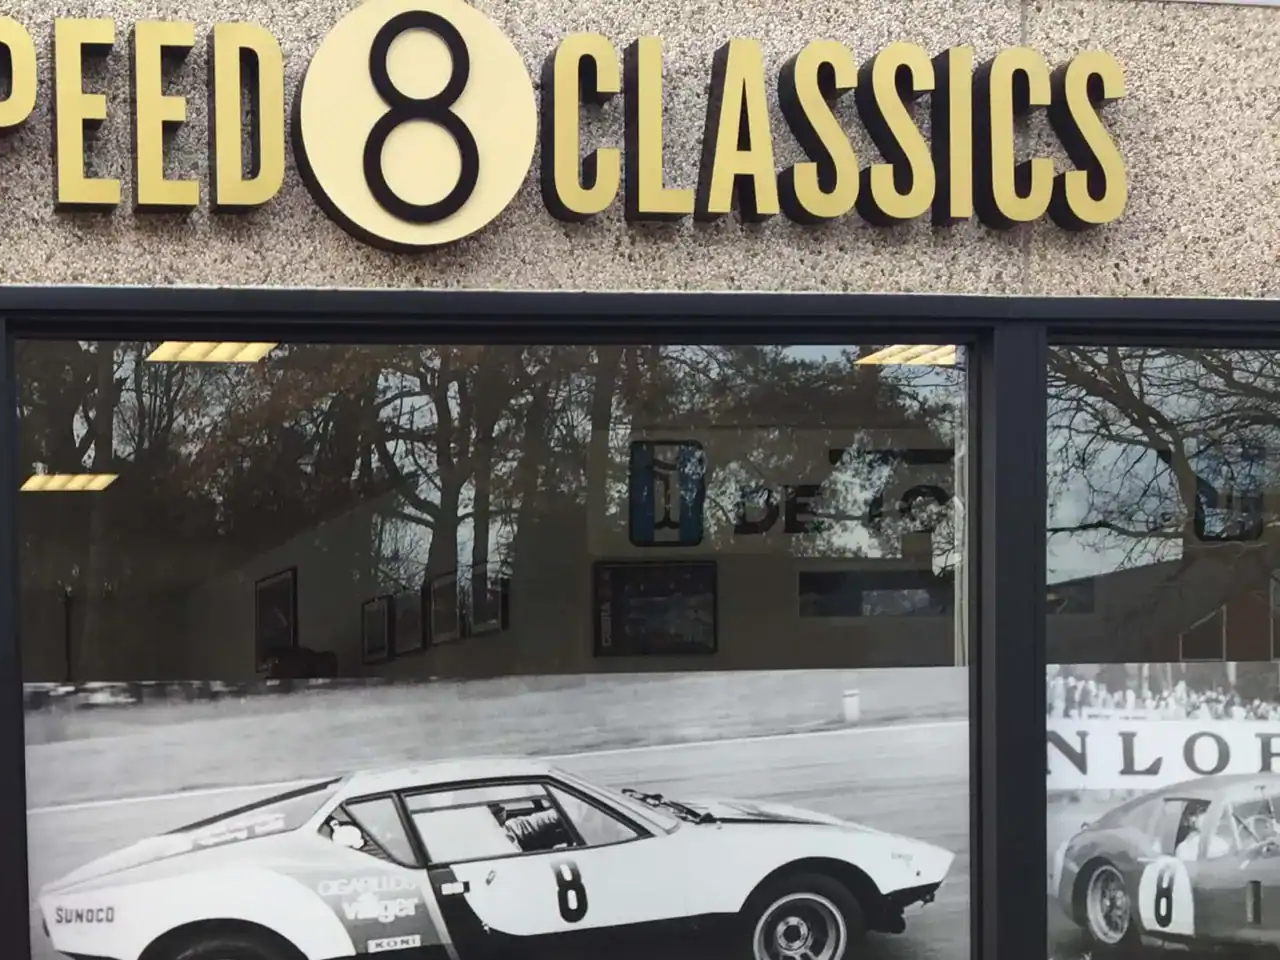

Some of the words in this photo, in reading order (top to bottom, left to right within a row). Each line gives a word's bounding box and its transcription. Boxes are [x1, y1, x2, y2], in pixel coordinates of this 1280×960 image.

[362, 9, 480, 223] 8
[550, 32, 1129, 226] CLASSICS
[55, 906, 115, 924] SUNOCO
[552, 860, 588, 924] 8
